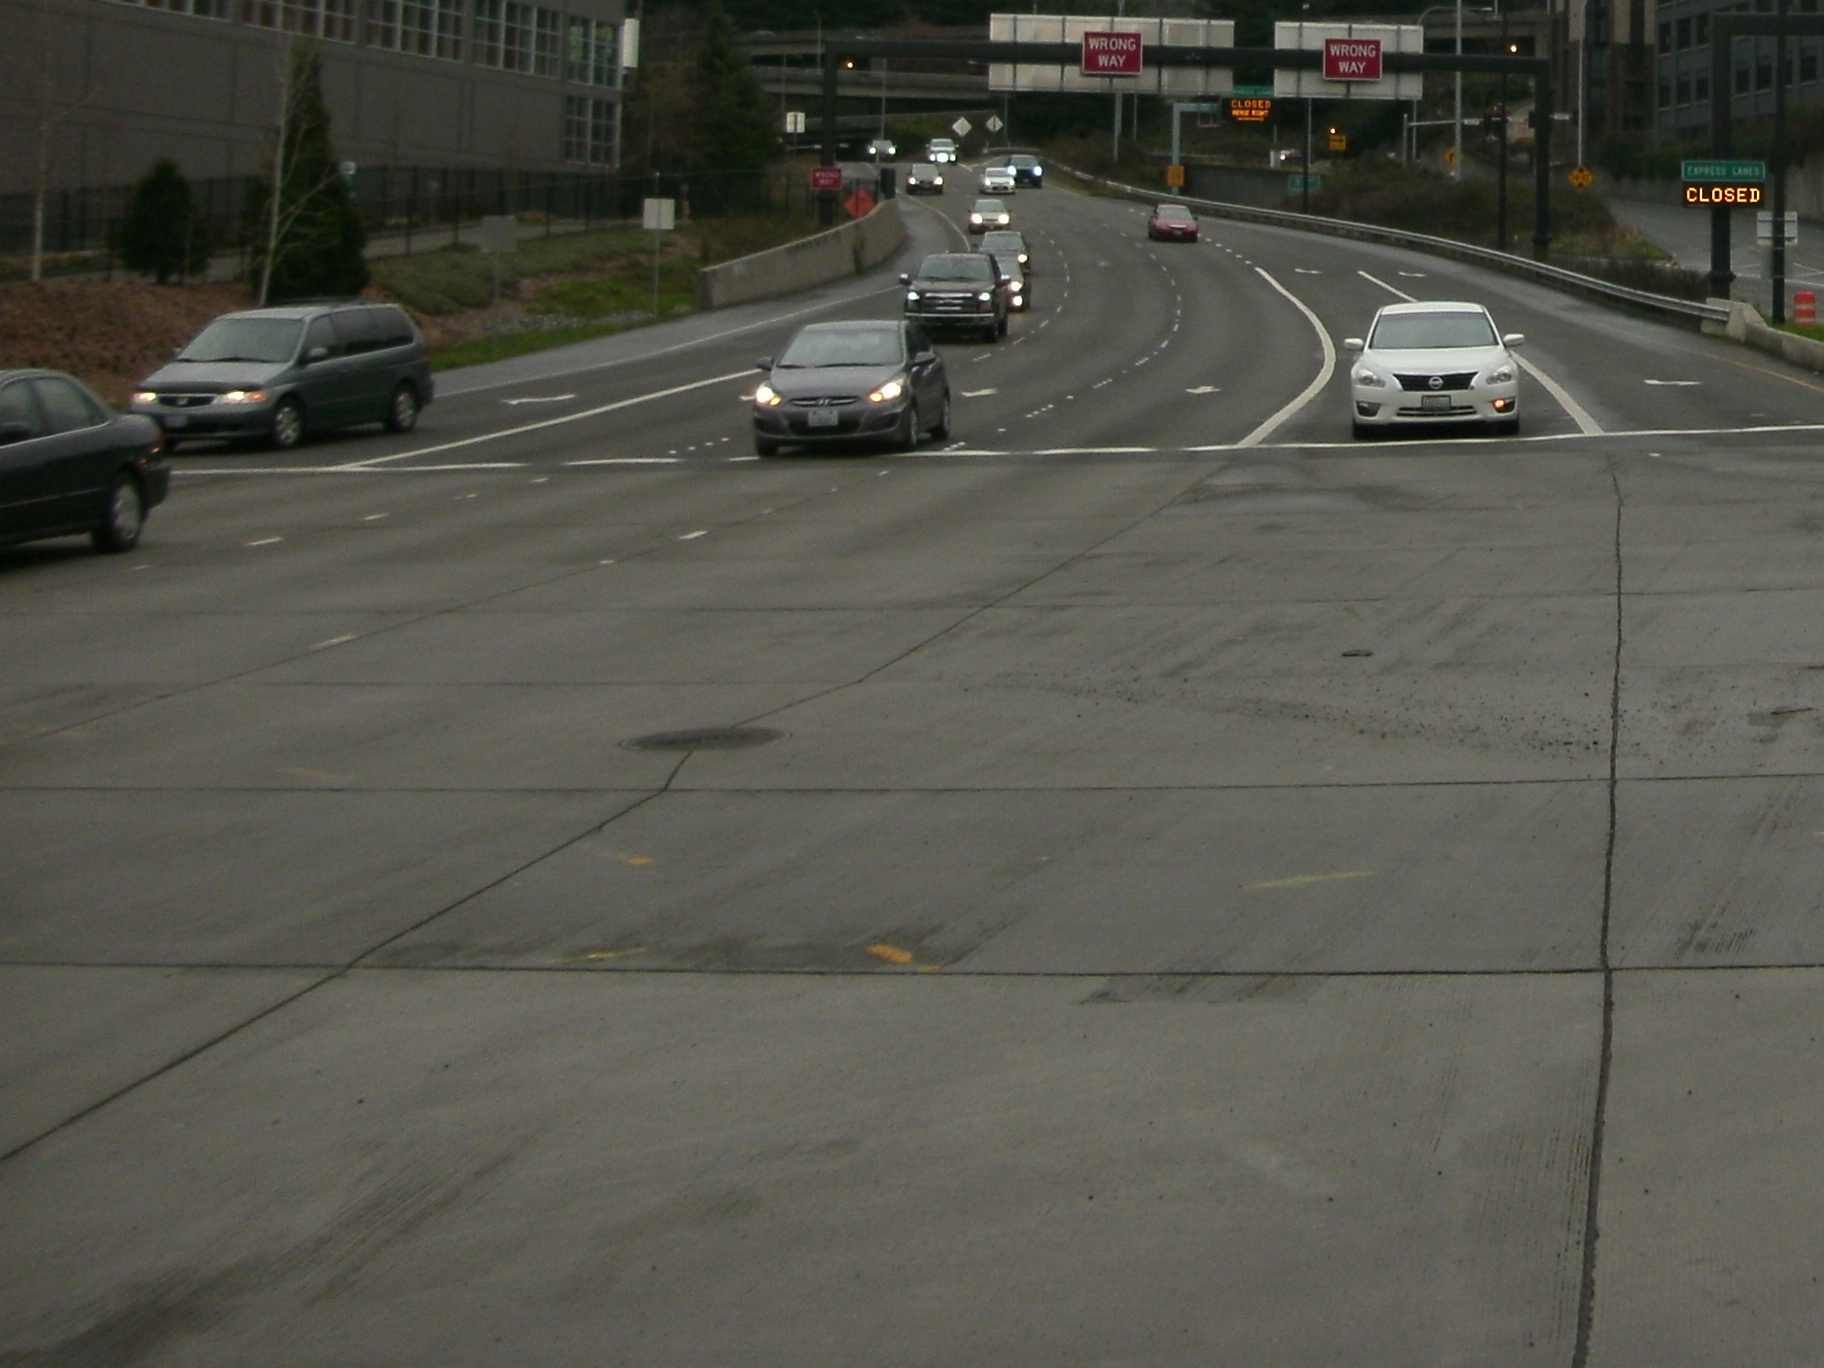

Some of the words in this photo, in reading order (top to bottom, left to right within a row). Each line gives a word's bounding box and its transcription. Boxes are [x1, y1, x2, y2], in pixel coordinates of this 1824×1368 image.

[1089, 37, 1137, 51] WRONG
[1330, 44, 1377, 58] WRONG
[1098, 54, 1126, 68] WAY
[1339, 61, 1366, 74] WAY
[1231, 99, 1271, 109] CLOSED
[1687, 166, 1726, 176] EXPRESS
[1733, 166, 1760, 176] LANES
[1686, 187, 1760, 203] CLOSED
